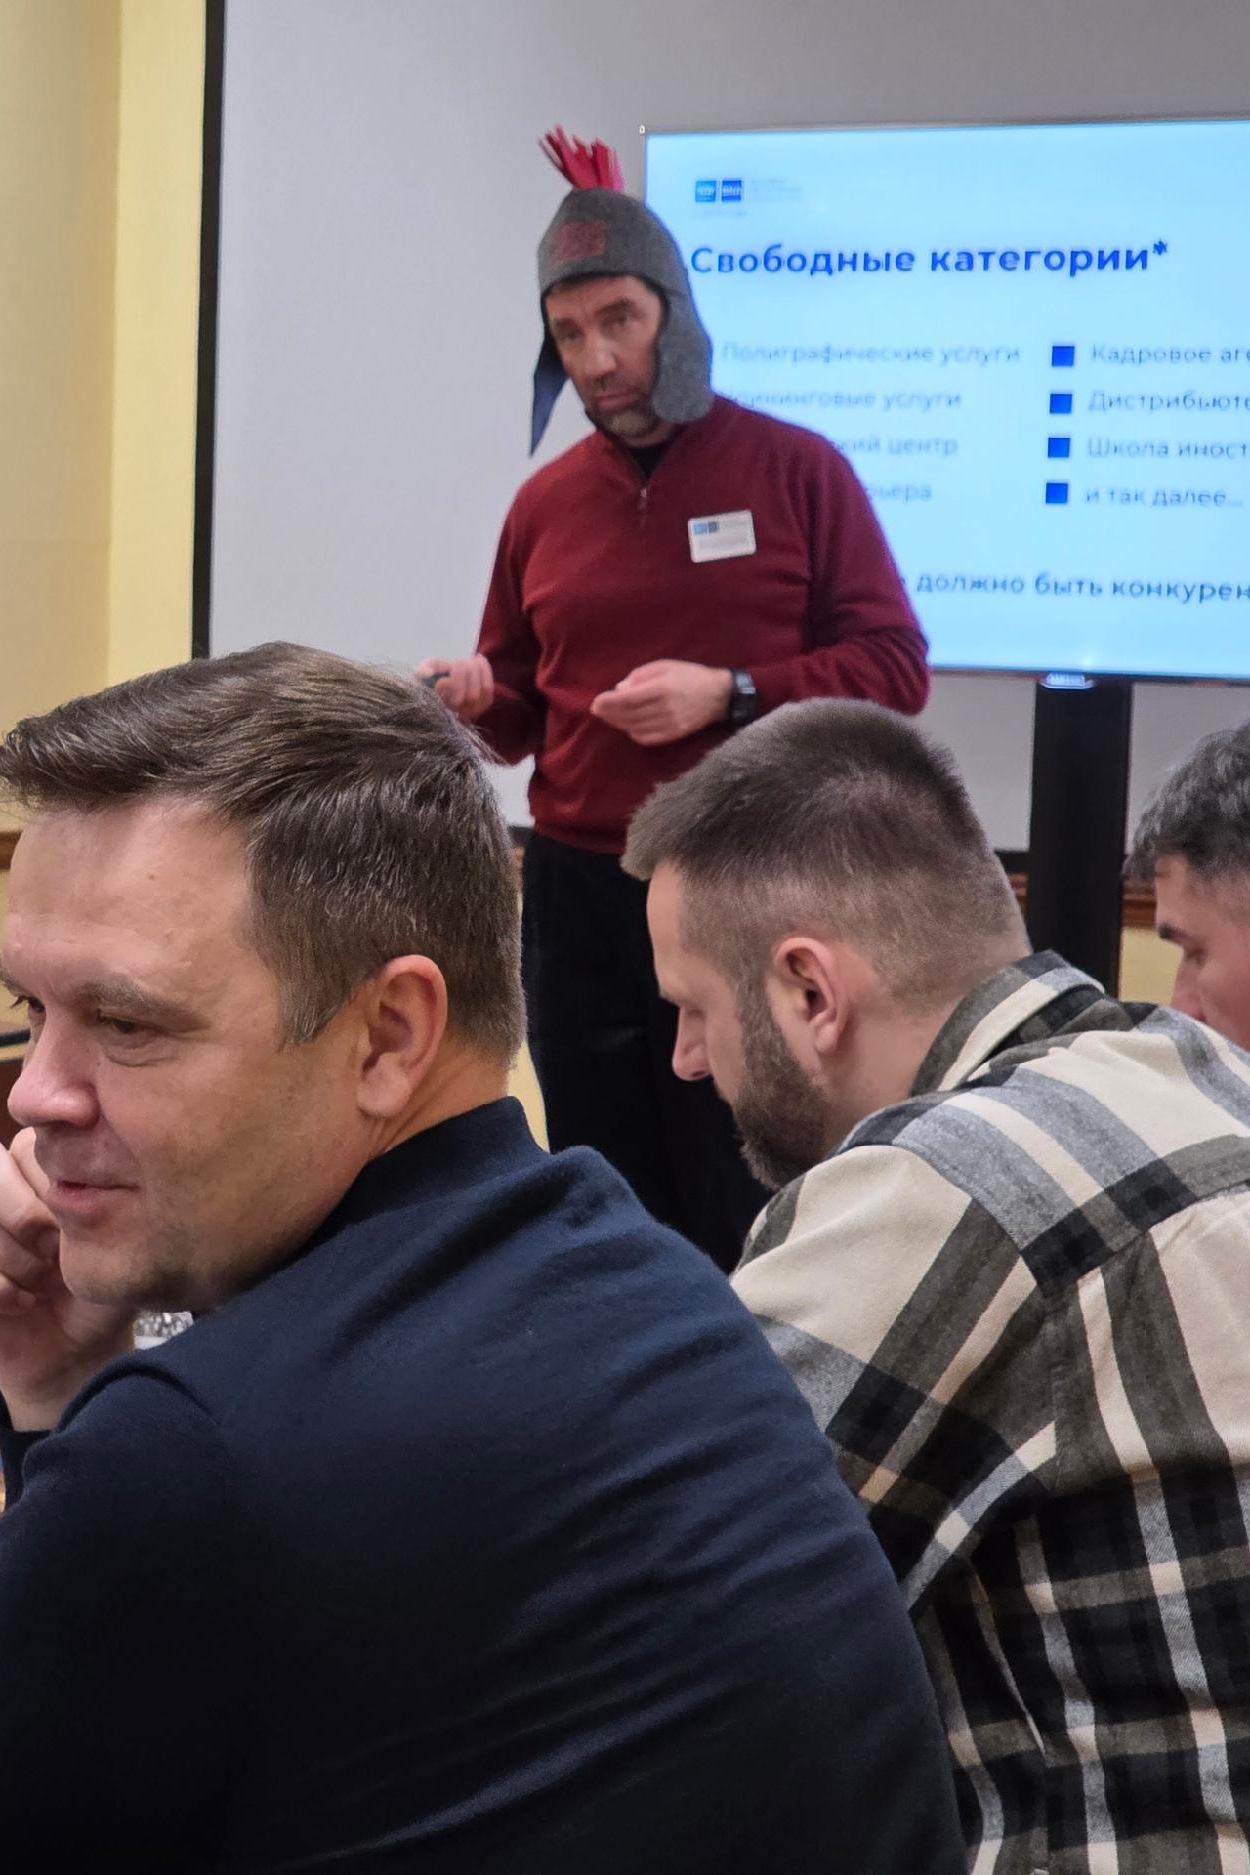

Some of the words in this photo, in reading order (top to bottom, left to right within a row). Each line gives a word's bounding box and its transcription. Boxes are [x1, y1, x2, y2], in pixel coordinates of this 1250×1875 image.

[690, 243, 915, 276] Свободные
[940, 346, 1021, 366] услуги
[1092, 344, 1212, 365] Кадровое
[883, 392, 962, 412] услуги
[887, 437, 959, 457] центр
[1087, 437, 1169, 458] Школа
[1086, 489, 1100, 504] и
[1109, 489, 1145, 505] так
[915, 573, 1025, 594] должно
[1035, 570, 1104, 597] быть
